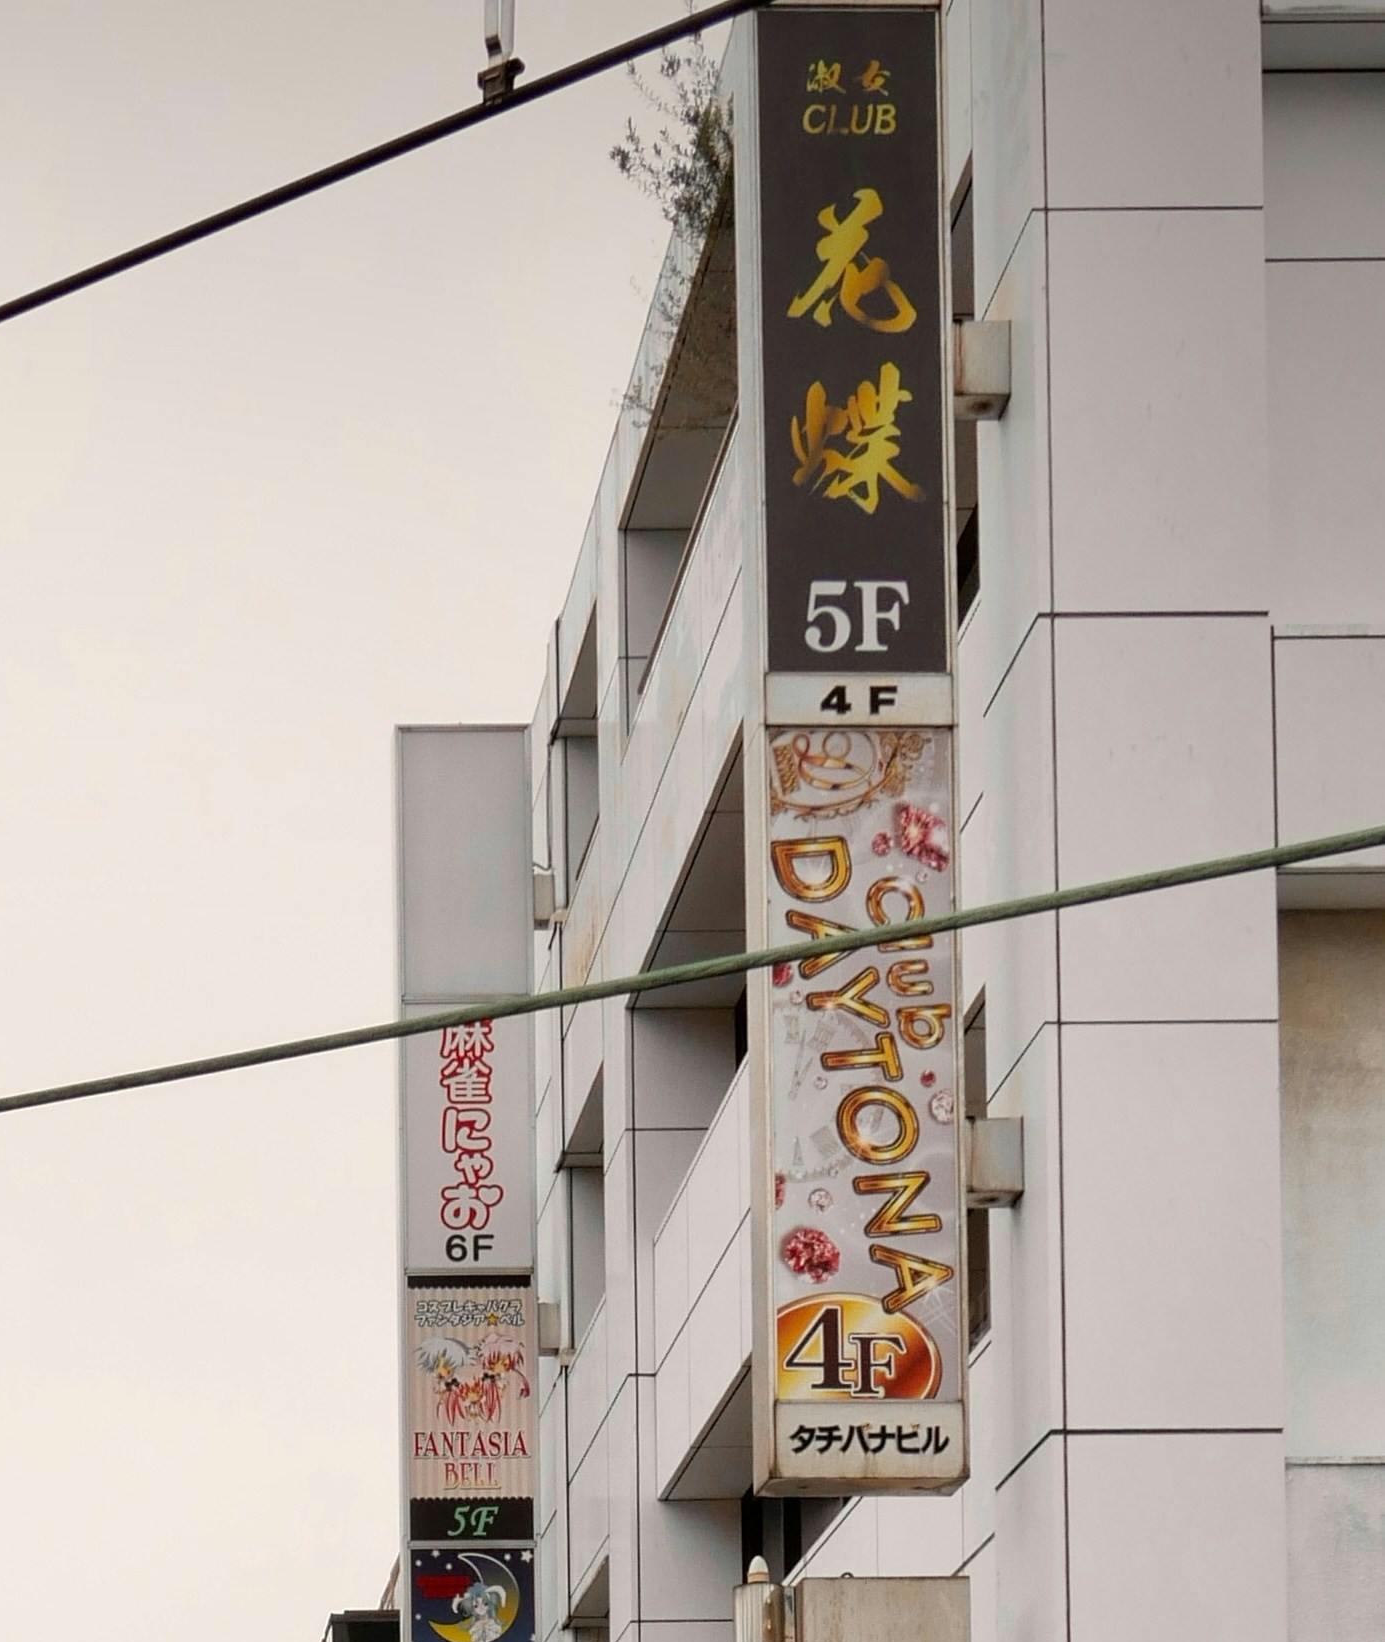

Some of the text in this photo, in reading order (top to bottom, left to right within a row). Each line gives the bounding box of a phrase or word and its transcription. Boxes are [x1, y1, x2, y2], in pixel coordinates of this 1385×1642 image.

[802, 103, 897, 136] CLUB
[805, 580, 910, 653] 5F
[820, 686, 898, 715] 4F
[771, 837, 954, 1315] DAYTONA
[446, 1234, 494, 1262] 6F
[783, 1307, 907, 1397] 4F
[414, 1431, 530, 1459] FANTASIA
[789, 1422, 950, 1456] タチバナビル
[443, 1462, 501, 1489] BELL
[447, 1505, 498, 1536] 5F
